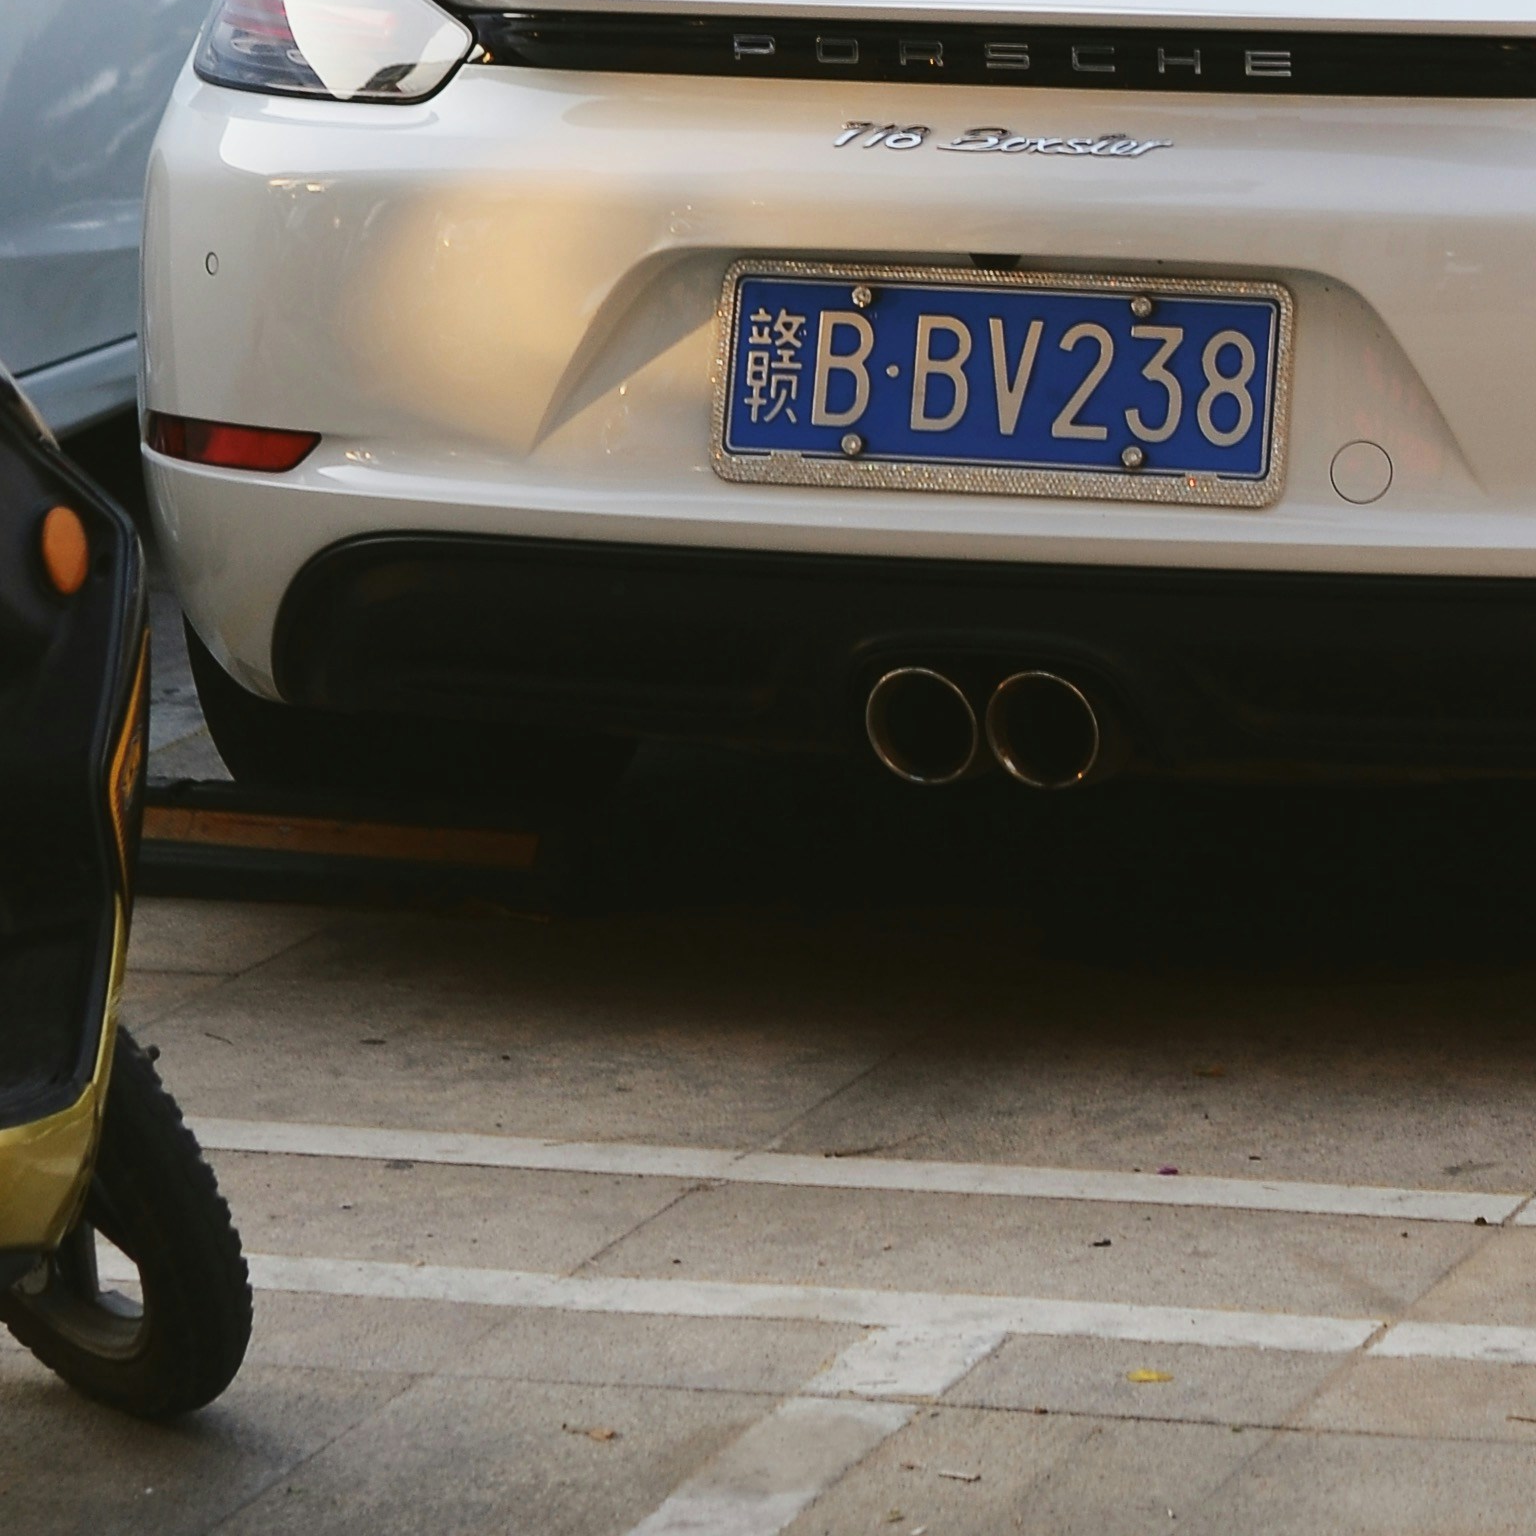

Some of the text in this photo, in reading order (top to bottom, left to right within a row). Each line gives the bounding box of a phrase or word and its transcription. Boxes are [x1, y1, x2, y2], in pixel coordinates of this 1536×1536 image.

[733, 34, 1291, 77] PORSCHE
[833, 120, 1173, 159] 718 Boxster
